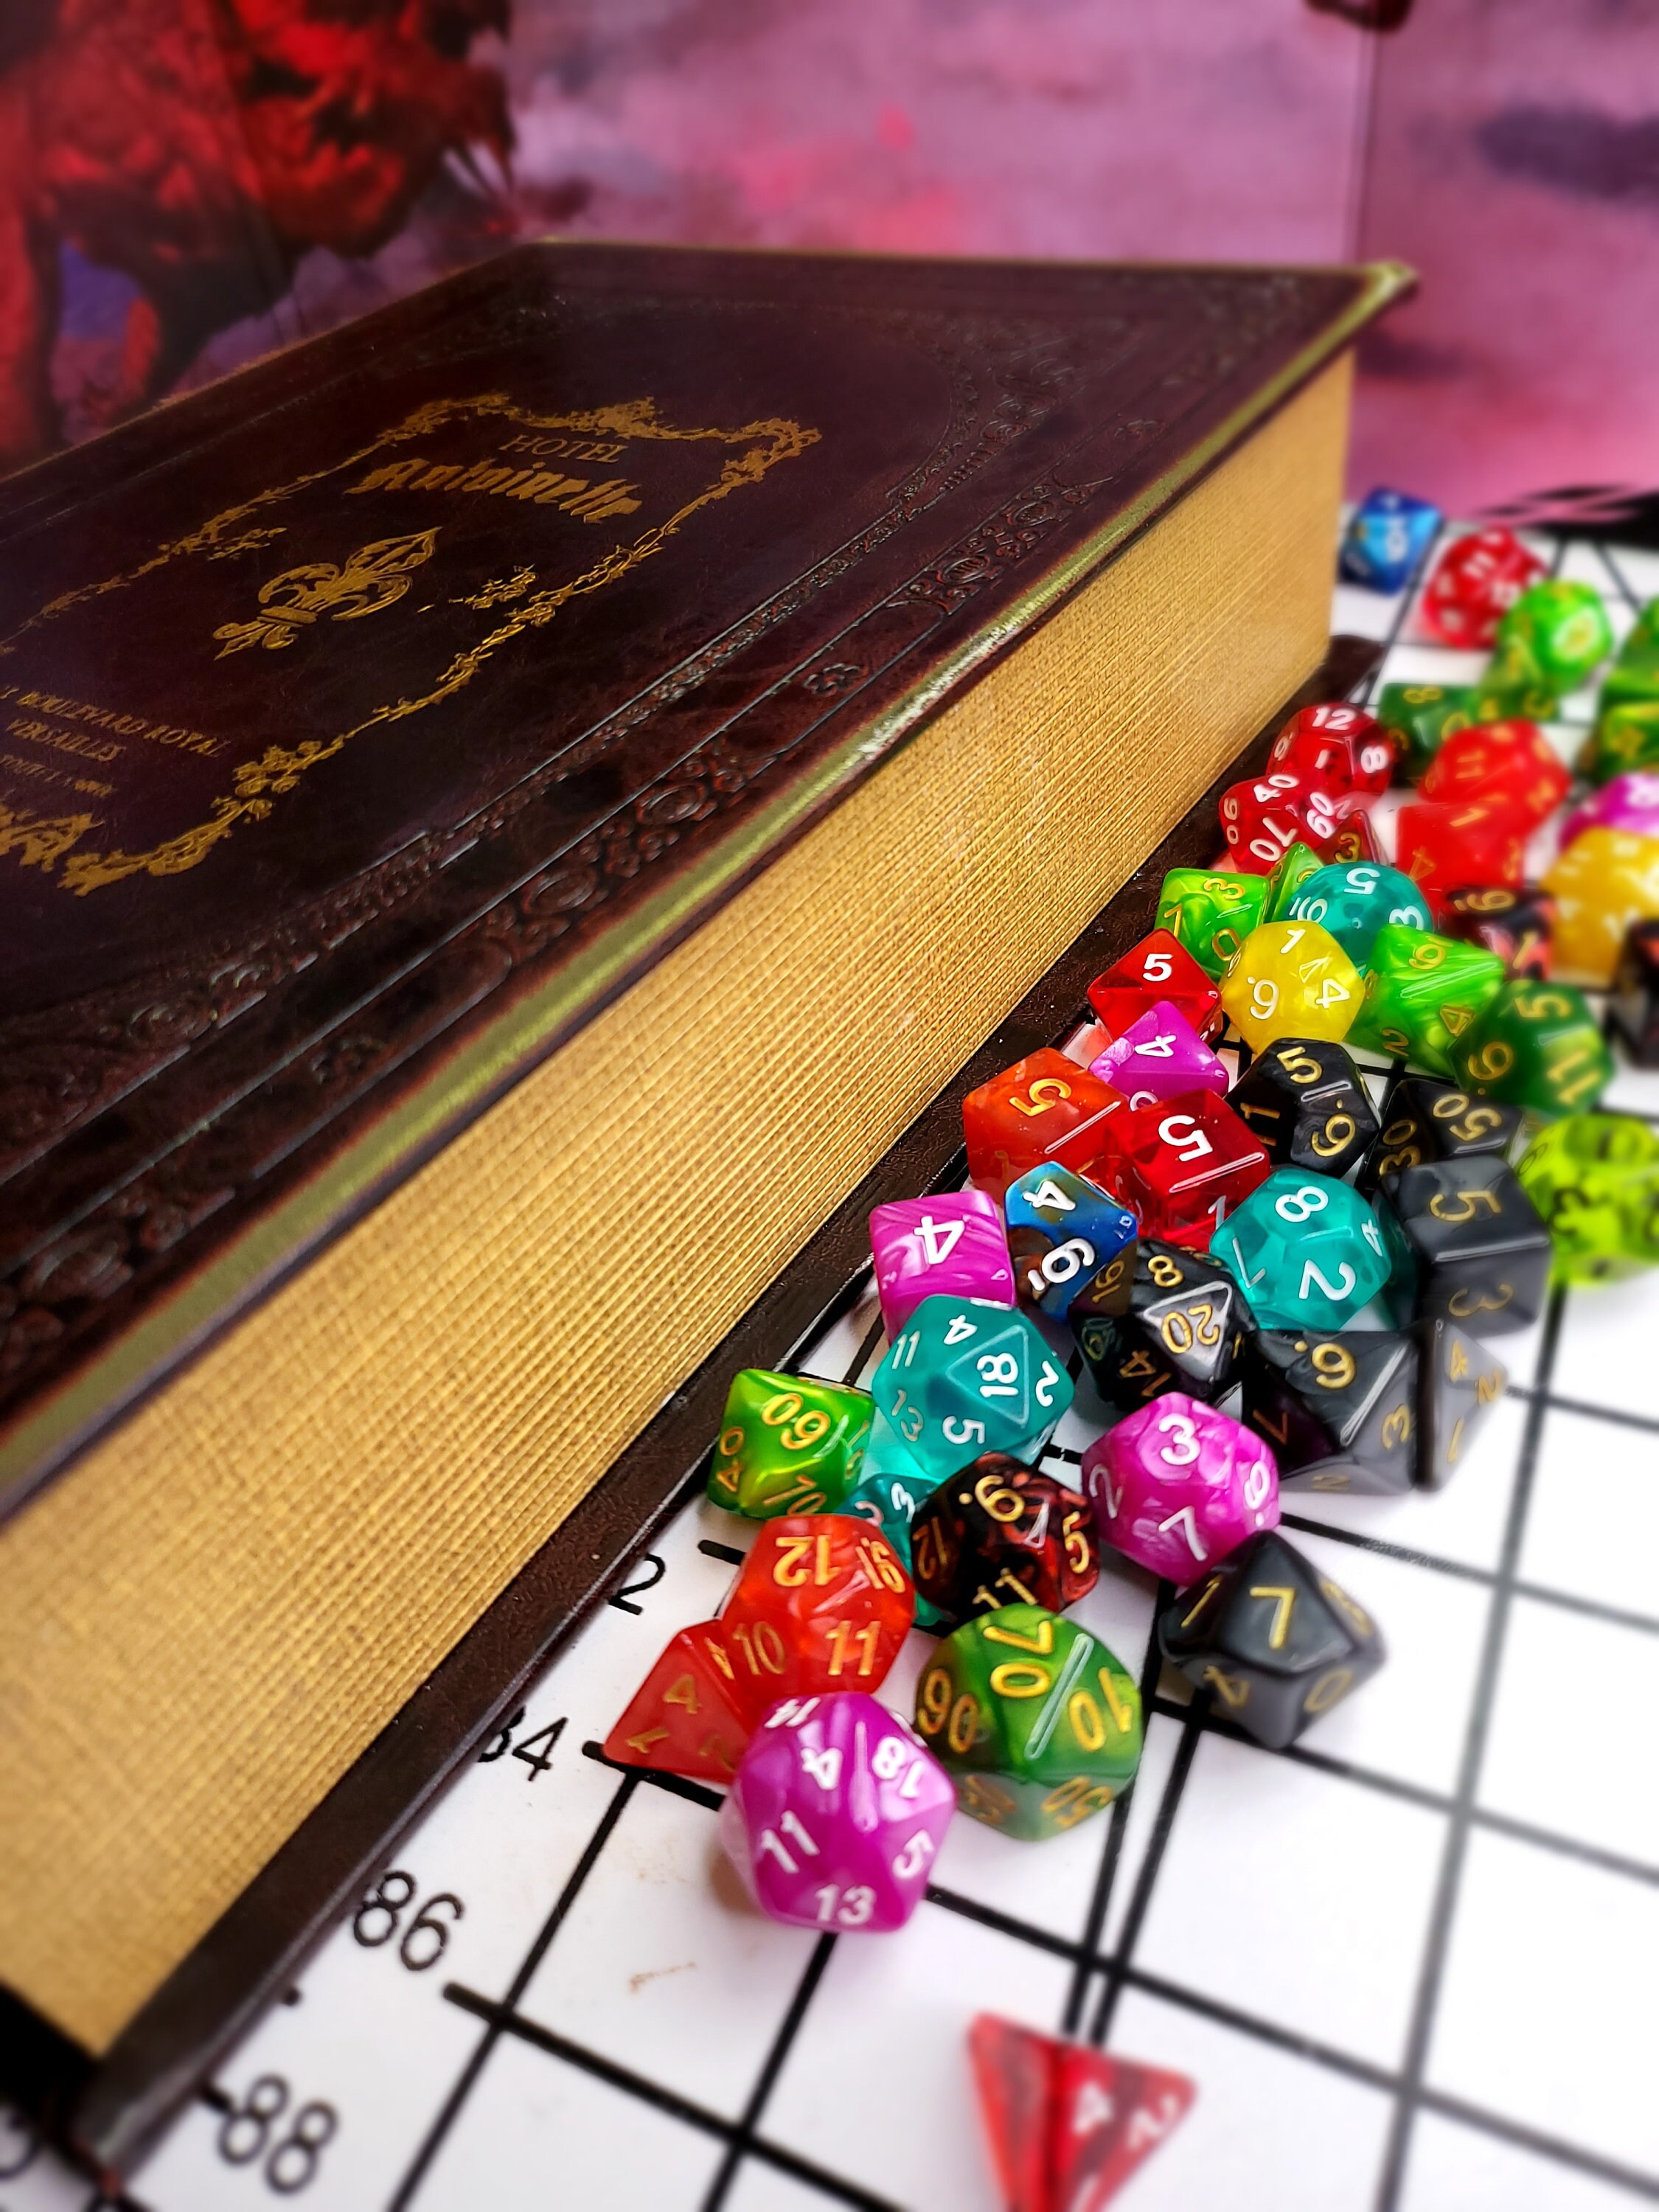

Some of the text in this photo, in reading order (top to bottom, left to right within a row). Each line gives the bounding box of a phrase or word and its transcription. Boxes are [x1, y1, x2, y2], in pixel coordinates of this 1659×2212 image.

[498, 434, 631, 465] HOTEL
[1312, 705, 1357, 731] 12
[142, 723, 232, 759] ROYAL
[1360, 745, 1389, 773] 8
[1253, 774, 1299, 803] 40
[1203, 877, 1245, 901] 3
[1343, 868, 1380, 894] 5
[1280, 928, 1306, 954] 1
[1143, 953, 1172, 981] 5
[1315, 978, 1351, 1009] 4
[1514, 994, 1573, 1018] 5
[1134, 1034, 1178, 1058] 4
[1381, 1029, 1411, 1057] 2
[1277, 1046, 1323, 1084] 5
[1009, 1078, 1072, 1117] 5
[1158, 1115, 1214, 1162] 5
[1023, 1180, 1077, 1211] 4
[1275, 1185, 1329, 1223] 8
[1429, 1189, 1502, 1222] 5
[914, 1215, 965, 1265] 4
[1360, 1218, 1384, 1258] 4
[1147, 1255, 1184, 1288] 8
[1231, 1237, 1267, 1289] 7
[1298, 1258, 1357, 1301] 2
[1447, 1284, 1514, 1318] 3
[943, 1314, 978, 1346] 4
[1161, 1303, 1220, 1354] 20
[891, 1330, 921, 1370] 11
[976, 1352, 1020, 1399] 18
[1034, 1360, 1060, 1407] 2
[891, 1388, 925, 1443] 13
[941, 1414, 987, 1446] 5
[1381, 1403, 1411, 1450] 3
[1158, 1413, 1202, 1467] 3
[1088, 1464, 1124, 1520] 2
[1062, 1510, 1091, 1574] 5
[1158, 1506, 1208, 1562] 7
[772, 1534, 843, 1588] 12
[971, 1566, 1038, 1611] 11
[1249, 1586, 1296, 1649] 7
[732, 1621, 788, 1677] 10
[825, 1621, 882, 1677] 11
[983, 1620, 1053, 1699] 70
[663, 1674, 703, 1714] 4
[1068, 1666, 1133, 1752] 10
[800, 1747, 844, 1790] 4
[871, 1736, 925, 1799] 18
[759, 1810, 820, 1874] 11
[892, 1829, 935, 1879] 5
[353, 1870, 465, 1972] 86
[815, 1884, 877, 1925] 13
[217, 2073, 339, 2196] 88
